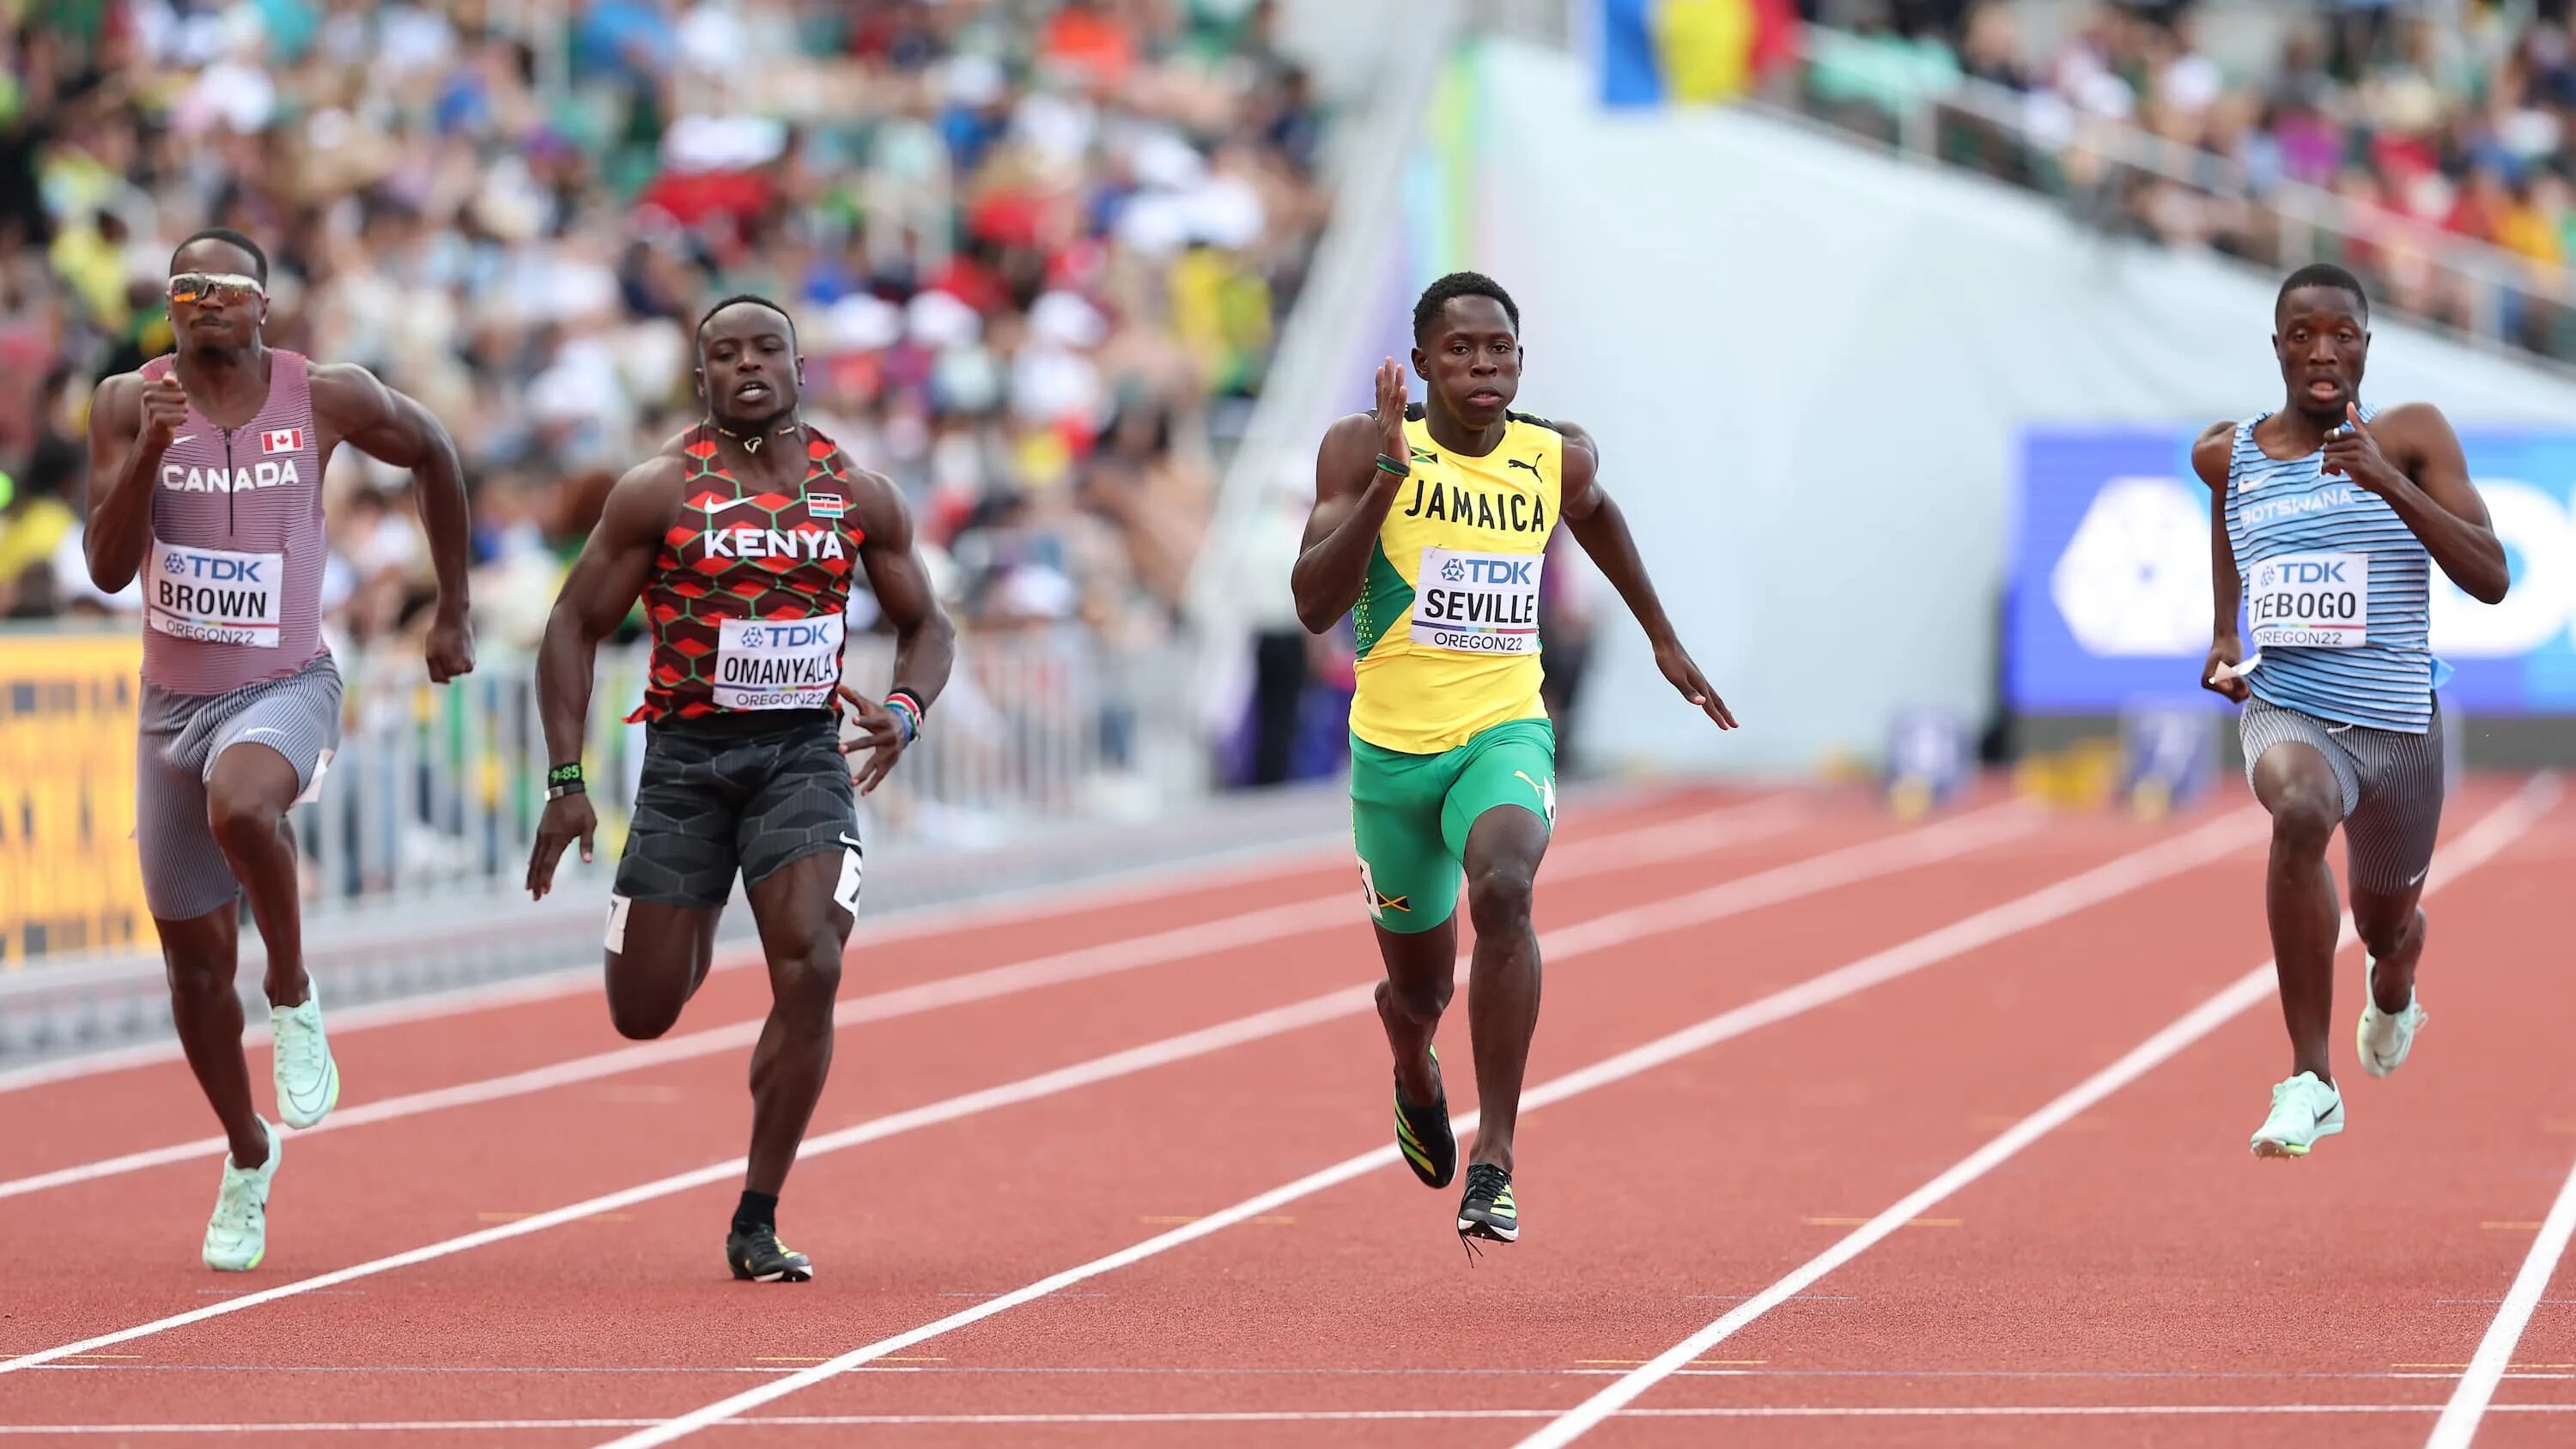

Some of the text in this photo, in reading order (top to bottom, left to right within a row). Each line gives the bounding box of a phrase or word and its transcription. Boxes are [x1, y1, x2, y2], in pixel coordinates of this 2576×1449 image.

[162, 459, 300, 493] CANADA
[1404, 479, 1545, 533] JAMAICA
[2239, 488, 2354, 525] BOTSWANA
[703, 527, 845, 560] KENYA
[186, 555, 261, 583] TDK
[1466, 559, 1532, 585] TDK
[2277, 561, 2346, 584] TDK
[160, 579, 267, 618] BROWN
[1425, 589, 1534, 623] SEVILLE
[2253, 591, 2356, 623] TEBOGO
[167, 619, 255, 644] OREGON22
[765, 622, 829, 647] TDK
[1434, 631, 1522, 651] OREGON22
[724, 654, 834, 685] OMANYALA
[736, 690, 824, 706] OREGON22
